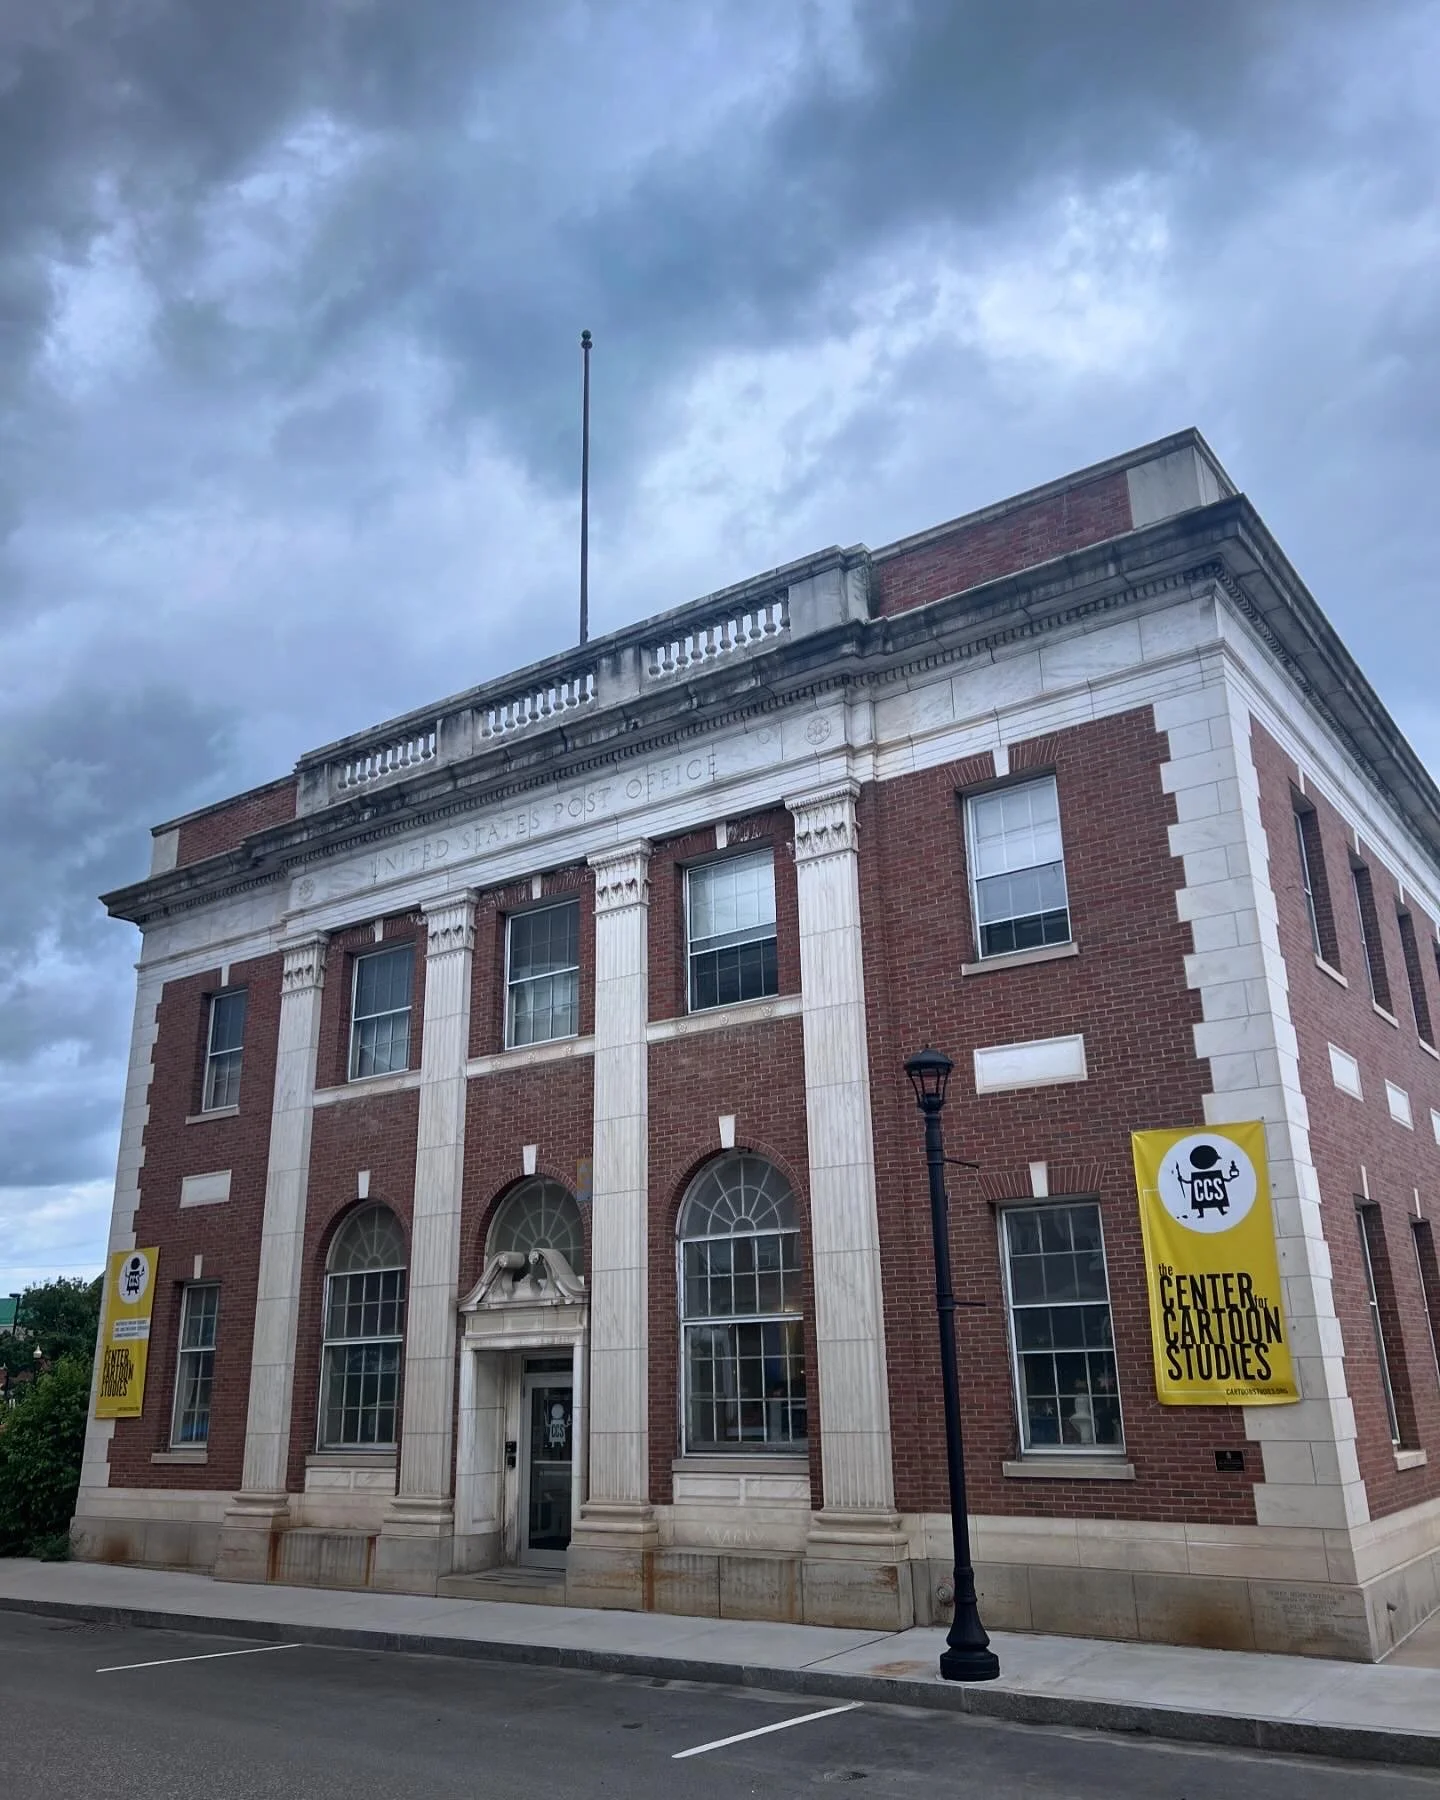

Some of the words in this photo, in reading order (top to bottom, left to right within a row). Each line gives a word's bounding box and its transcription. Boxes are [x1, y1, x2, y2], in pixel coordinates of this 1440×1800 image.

[370, 840, 449, 873] UNITED
[461, 813, 540, 850] STATES
[552, 787, 611, 823] POST
[625, 754, 719, 799] OFFICE
[1194, 1178, 1225, 1202] CCS
[1158, 1263, 1173, 1276] the
[1160, 1272, 1255, 1310] CENTER
[1253, 1294, 1268, 1308] for
[1163, 1304, 1282, 1344] CARTOON
[104, 1349, 129, 1368] CENTER
[1166, 1343, 1272, 1380] STUDIES
[100, 1378, 128, 1397] STUDIES
[552, 1424, 564, 1438] CCS
